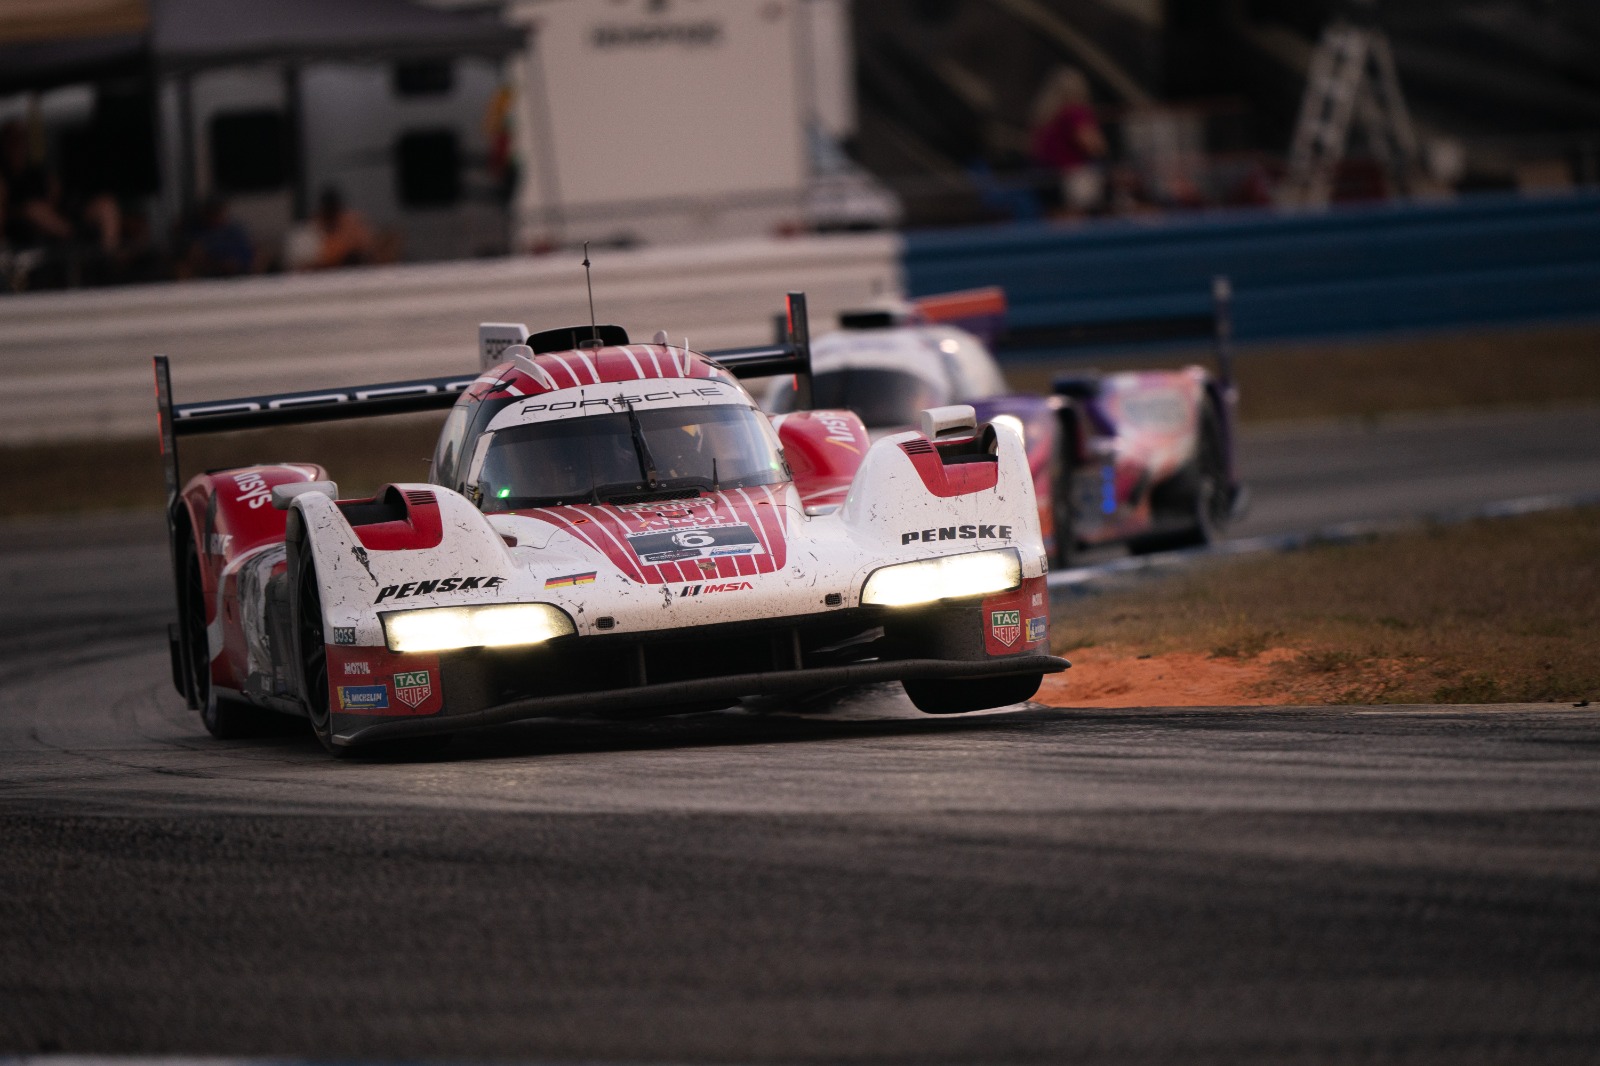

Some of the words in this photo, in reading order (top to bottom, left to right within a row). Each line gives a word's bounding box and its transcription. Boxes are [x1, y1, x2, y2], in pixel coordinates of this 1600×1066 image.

[520, 387, 724, 416] PORSCHE
[671, 530, 715, 548] 6
[901, 524, 1012, 546] PENSKE
[373, 576, 507, 605] PENSKE
[702, 581, 754, 594] IMSA
[994, 612, 1018, 625] TAG
[333, 628, 355, 644] BOSS
[994, 626, 1020, 644] HEUER
[344, 661, 371, 675] MOTUL
[396, 673, 428, 687] TAG
[351, 691, 382, 702] MICHELIN
[397, 686, 430, 705] HEUER
